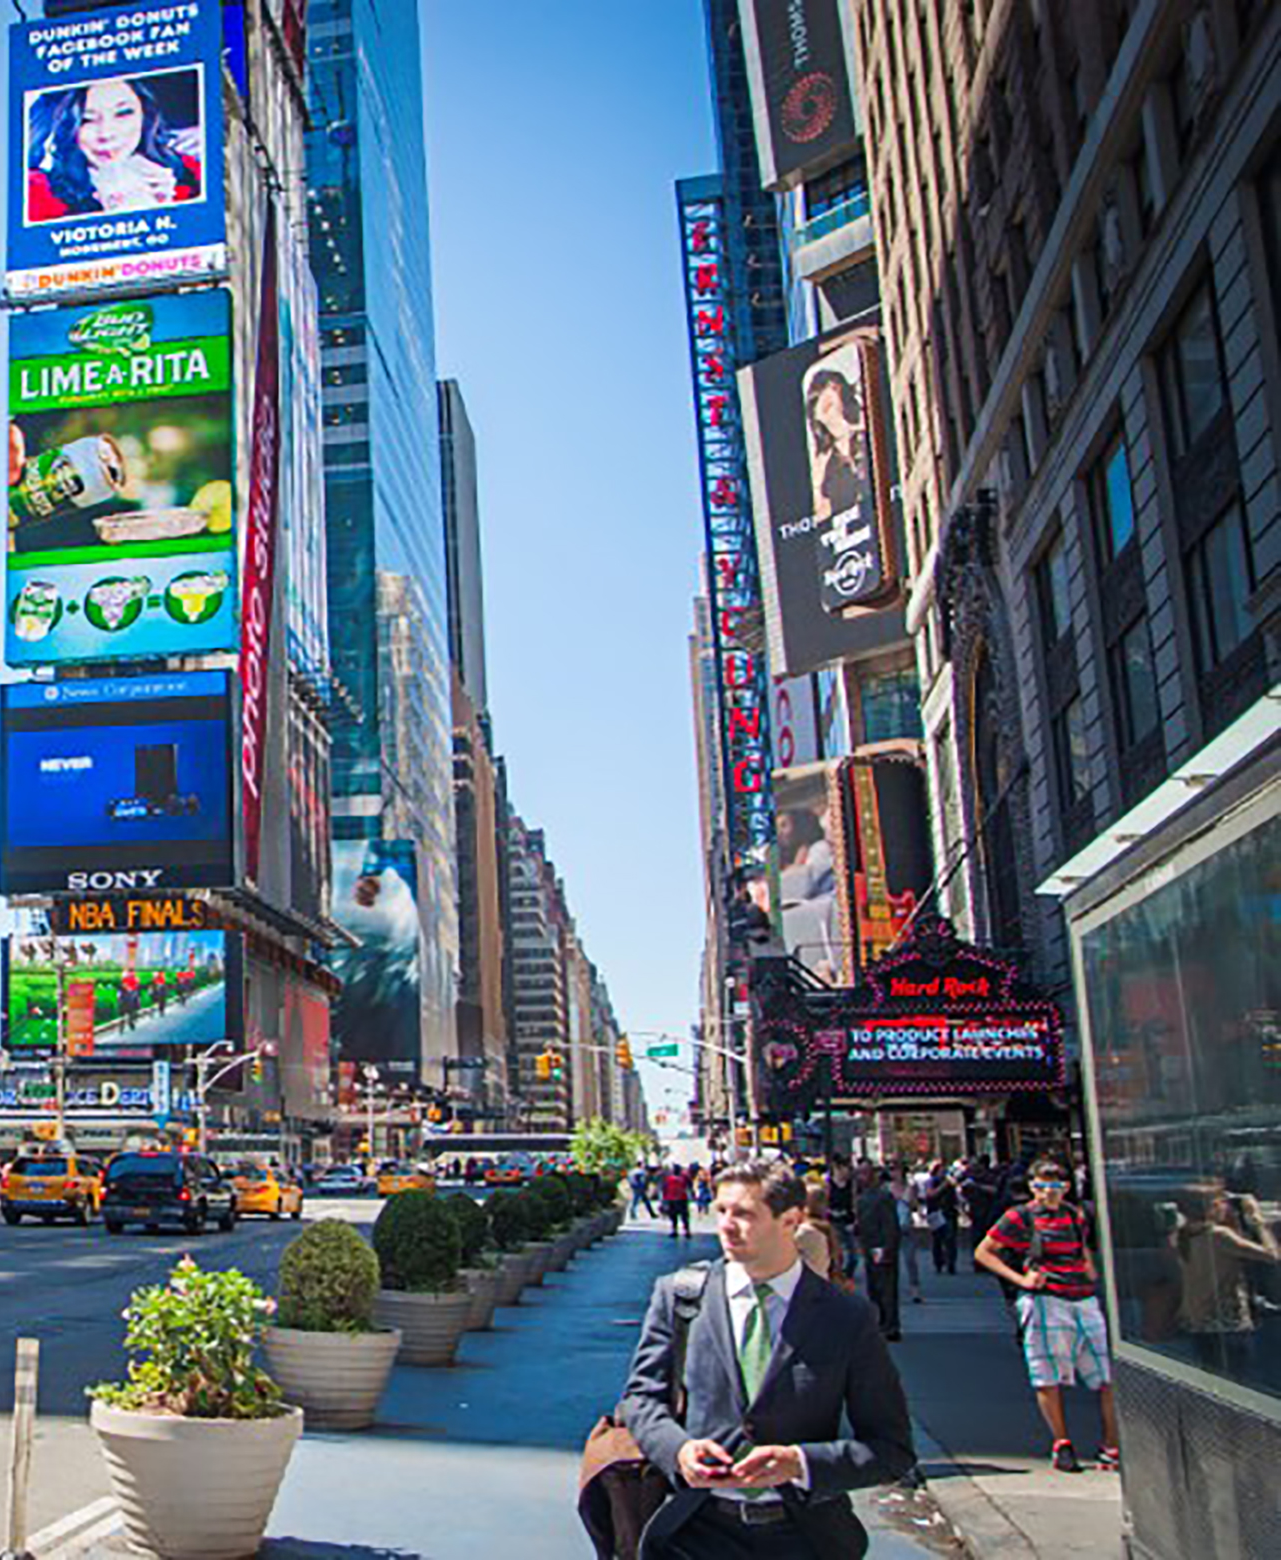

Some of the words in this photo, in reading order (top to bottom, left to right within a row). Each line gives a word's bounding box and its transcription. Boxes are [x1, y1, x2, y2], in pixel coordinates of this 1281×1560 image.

[116, 3, 199, 29] DONUTS
[36, 30, 144, 59] FACEBOOK
[150, 21, 191, 39] FAN
[47, 57, 73, 73] OF
[80, 50, 117, 68] THE
[123, 39, 180, 61] WEEK
[50, 219, 150, 244] VICTORIA
[122, 254, 202, 276] DONUTS
[68, 869, 163, 890] SONY
[69, 901, 116, 931] NBA
[127, 899, 207, 928] FINALS
[890, 977, 940, 997] Hard
[943, 977, 989, 999] Rock
[850, 1028, 871, 1042] TO
[876, 1028, 950, 1043] PRODUCT
[848, 1048, 884, 1062] AND
[887, 1046, 979, 1061] CORPORATE
[980, 1046, 1044, 1060] EVENTS
